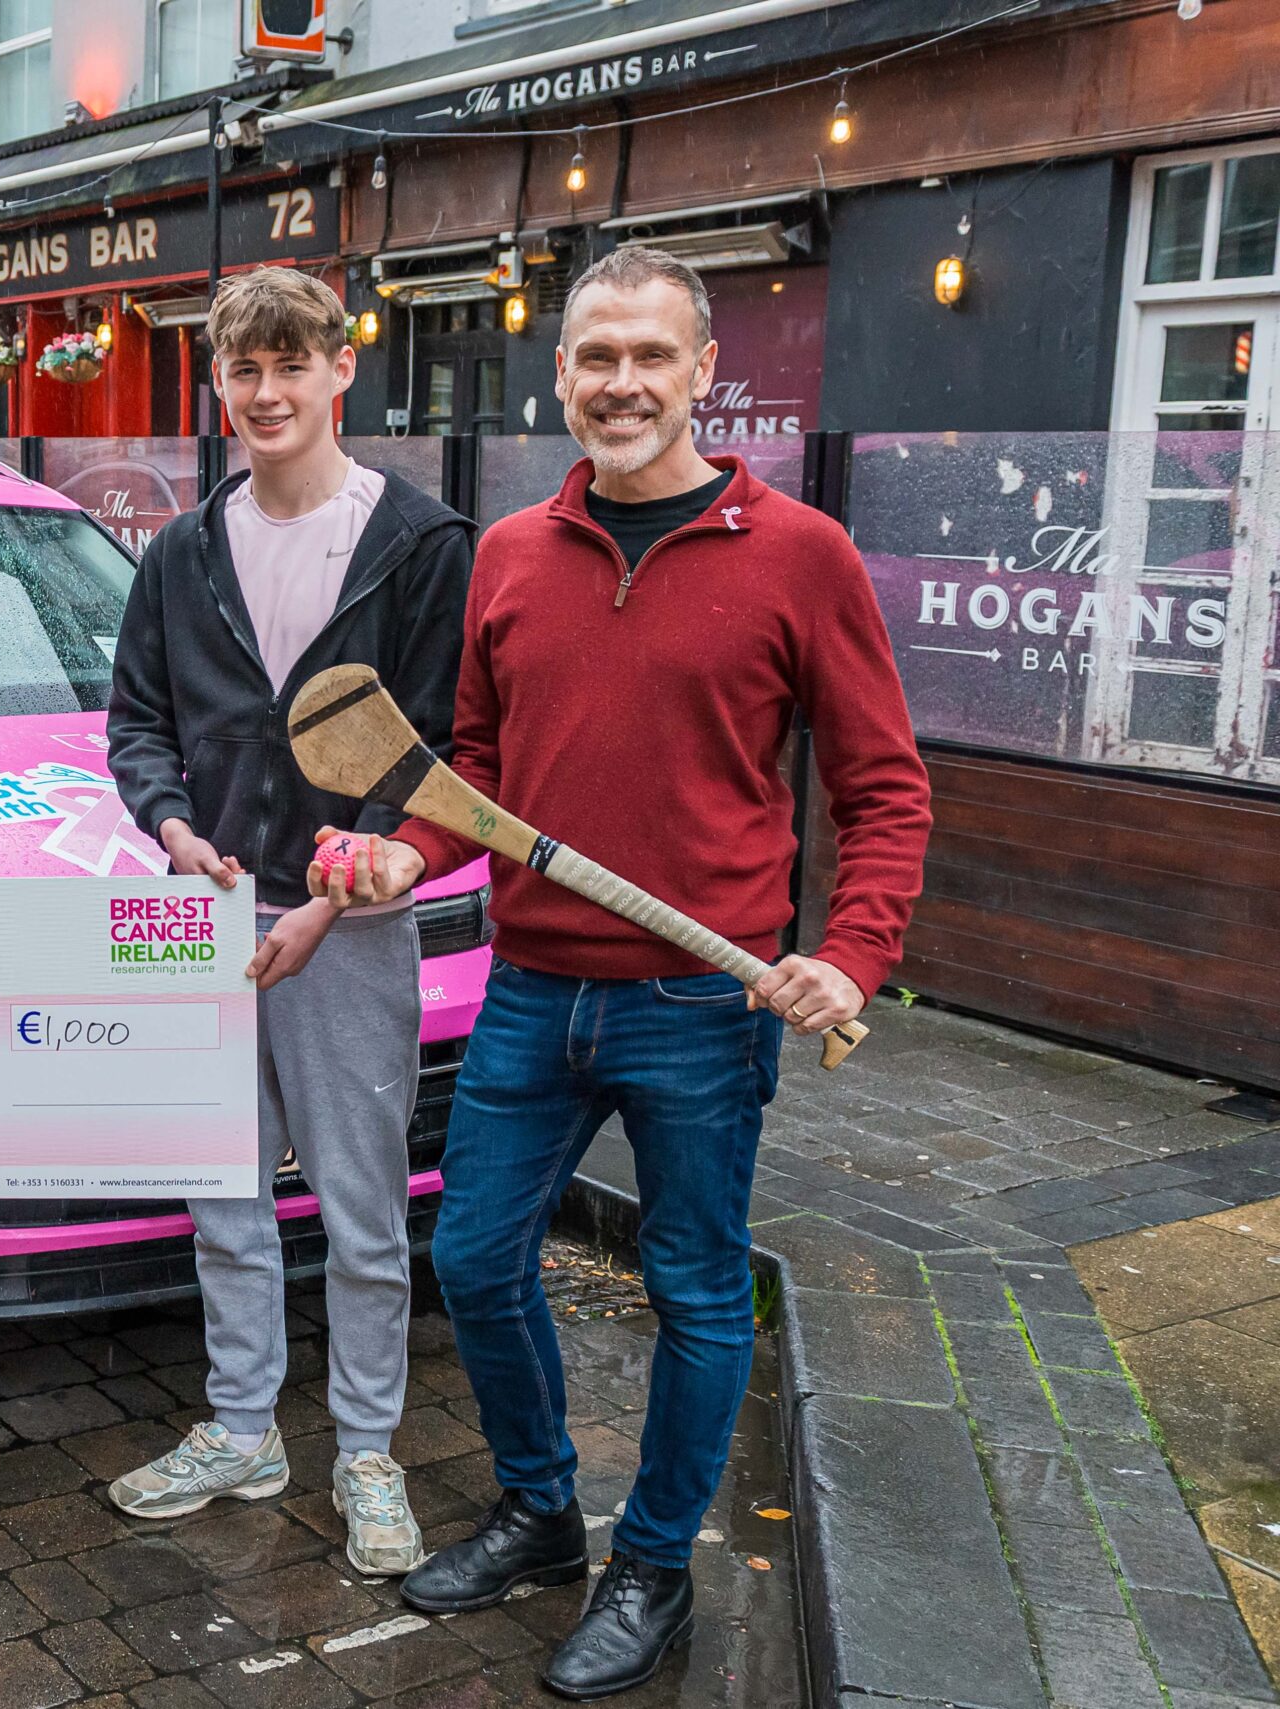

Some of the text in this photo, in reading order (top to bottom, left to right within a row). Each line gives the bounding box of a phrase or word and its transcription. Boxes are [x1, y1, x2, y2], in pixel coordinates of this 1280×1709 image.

[454, 50, 697, 119] Ma HOGANS BAR
[267, 188, 316, 240] 72
[89, 217, 158, 268] BAR
[698, 379, 753, 412] Ma
[691, 416, 801, 444] OGANS
[96, 487, 135, 519] Ma
[1004, 525, 1122, 576] Ma
[917, 579, 1227, 648] HOGANS
[1021, 647, 1097, 676] BAR
[111, 921, 214, 942] CANCER
[111, 943, 215, 962] IRELAND
[111, 964, 176, 976] researching
[190, 965, 215, 973] cure
[419, 984, 448, 1002] ket
[17, 1011, 130, 1051] €1,000
[6, 1177, 20, 1187] Tel:
[22, 1177, 42, 1187] +353
[51, 1177, 84, 1187] 5160331
[99, 1177, 223, 1187] www.breastcancerireland.com
